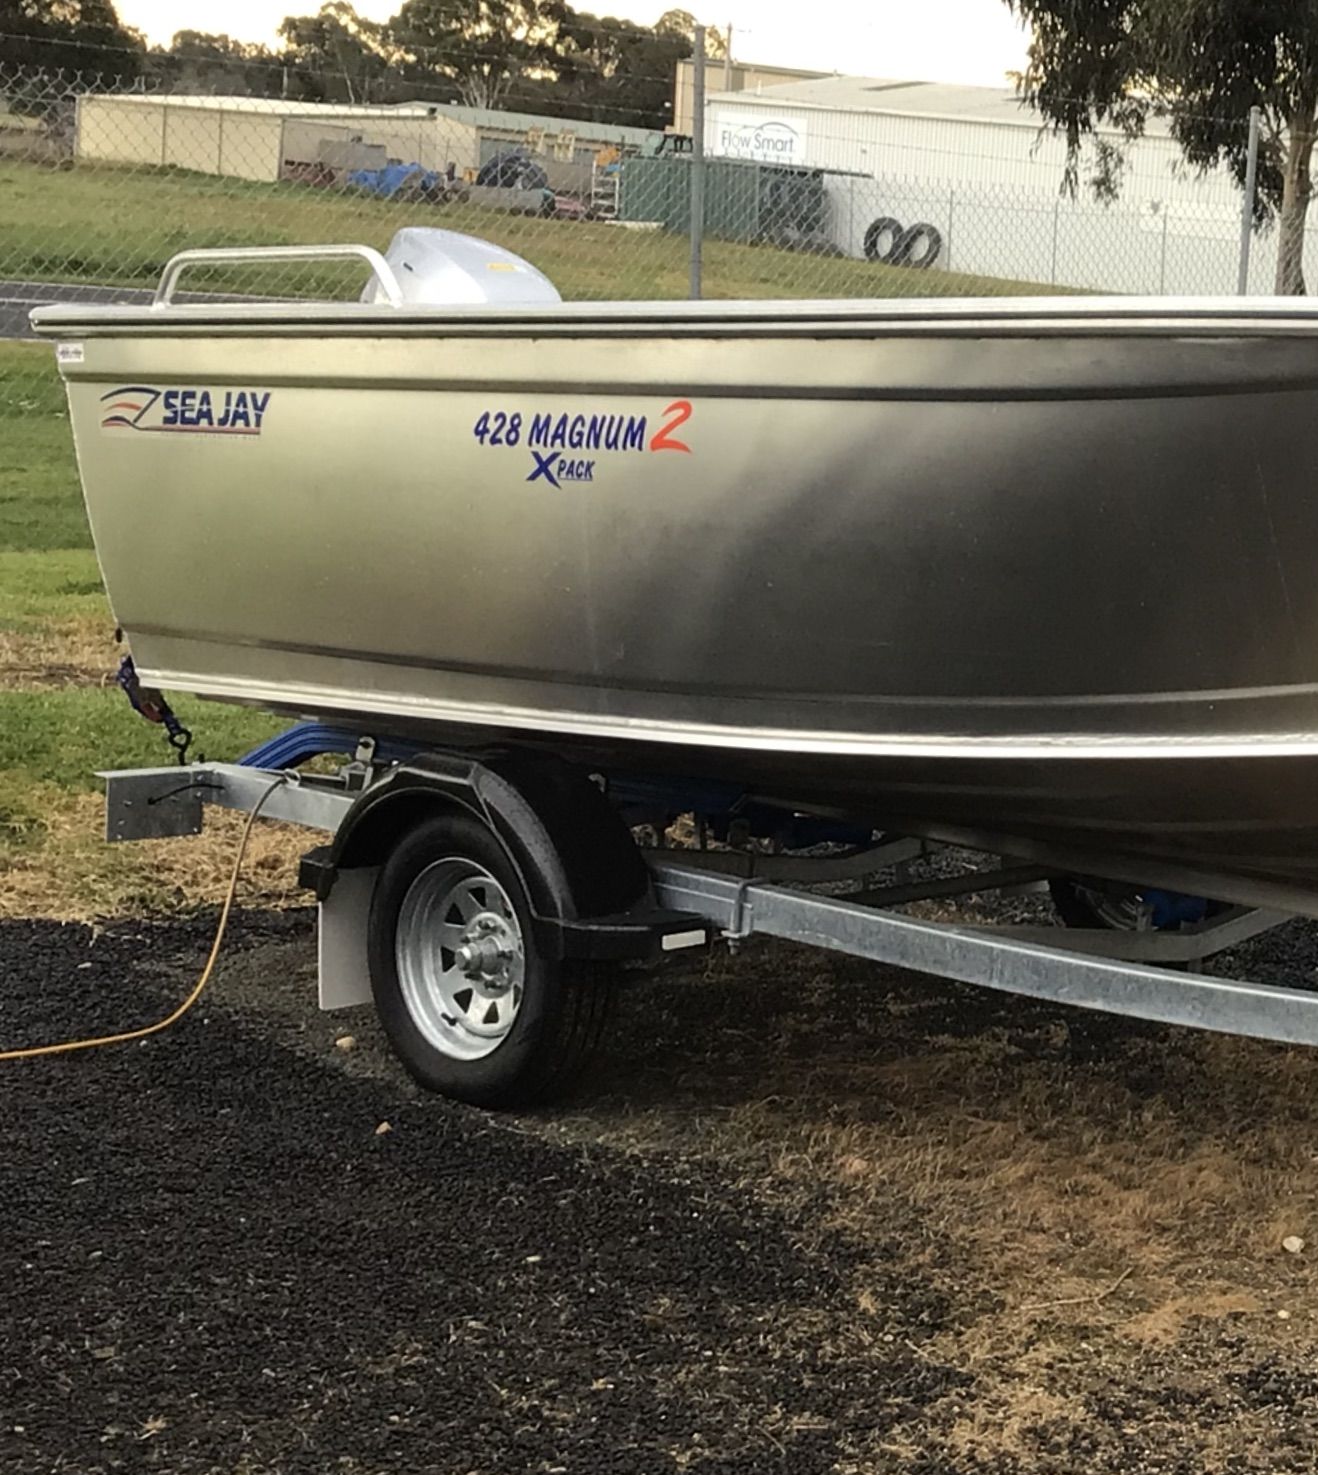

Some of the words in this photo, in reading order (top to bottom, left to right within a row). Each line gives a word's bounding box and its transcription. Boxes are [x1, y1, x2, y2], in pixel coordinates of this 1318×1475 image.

[721, 129, 752, 148] Flow
[754, 132, 794, 153] Smart
[162, 390, 214, 427] SEA
[218, 391, 271, 428] JAY
[473, 410, 523, 447] 428
[527, 411, 648, 452] MAGNUM
[649, 399, 693, 453] 2
